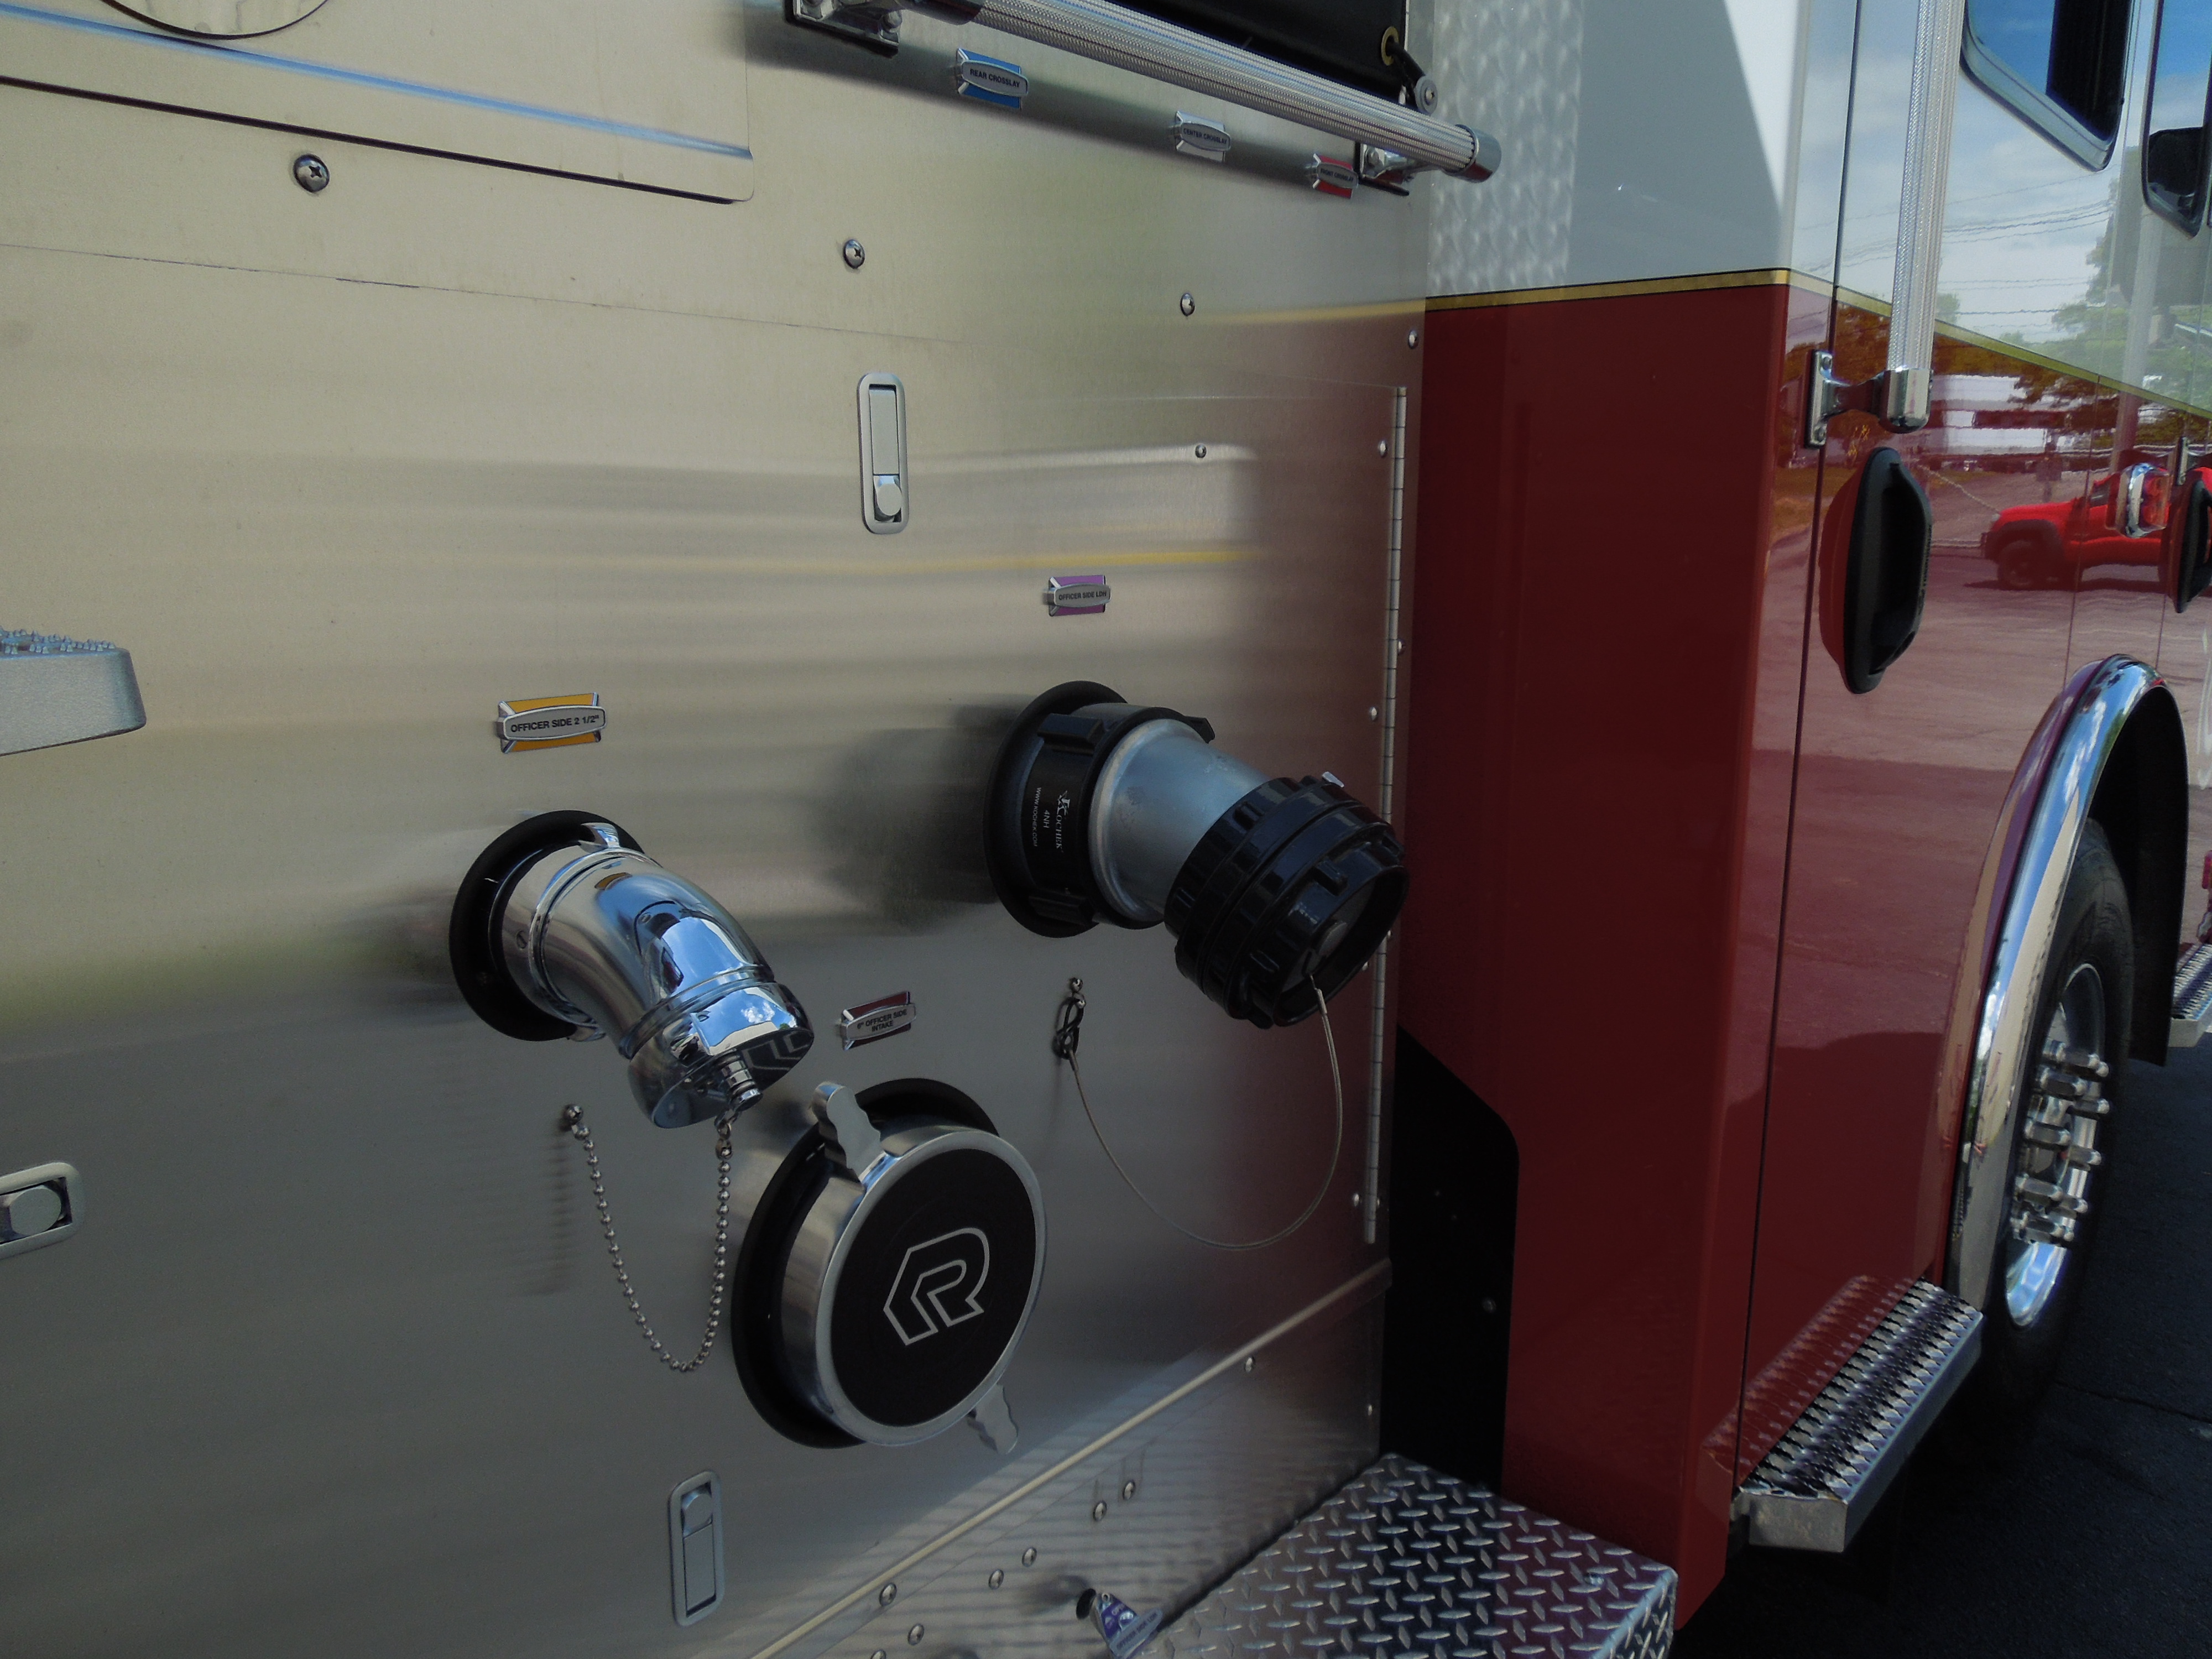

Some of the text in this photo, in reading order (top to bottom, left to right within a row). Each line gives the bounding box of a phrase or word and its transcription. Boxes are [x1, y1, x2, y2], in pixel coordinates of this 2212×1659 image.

[970, 68, 1020, 88] REAR CROSSLAY
[1058, 592, 1082, 601] OFFICER
[510, 721, 550, 733] OFFICER
[551, 718, 572, 728] SIDE
[582, 714, 599, 724] 1/2"
[1032, 786, 1042, 847] WWW.KOCHEK.COM
[865, 1014, 892, 1027] OFFICER
[893, 1009, 907, 1019] SIDE
[872, 1020, 893, 1032] INTAKE
